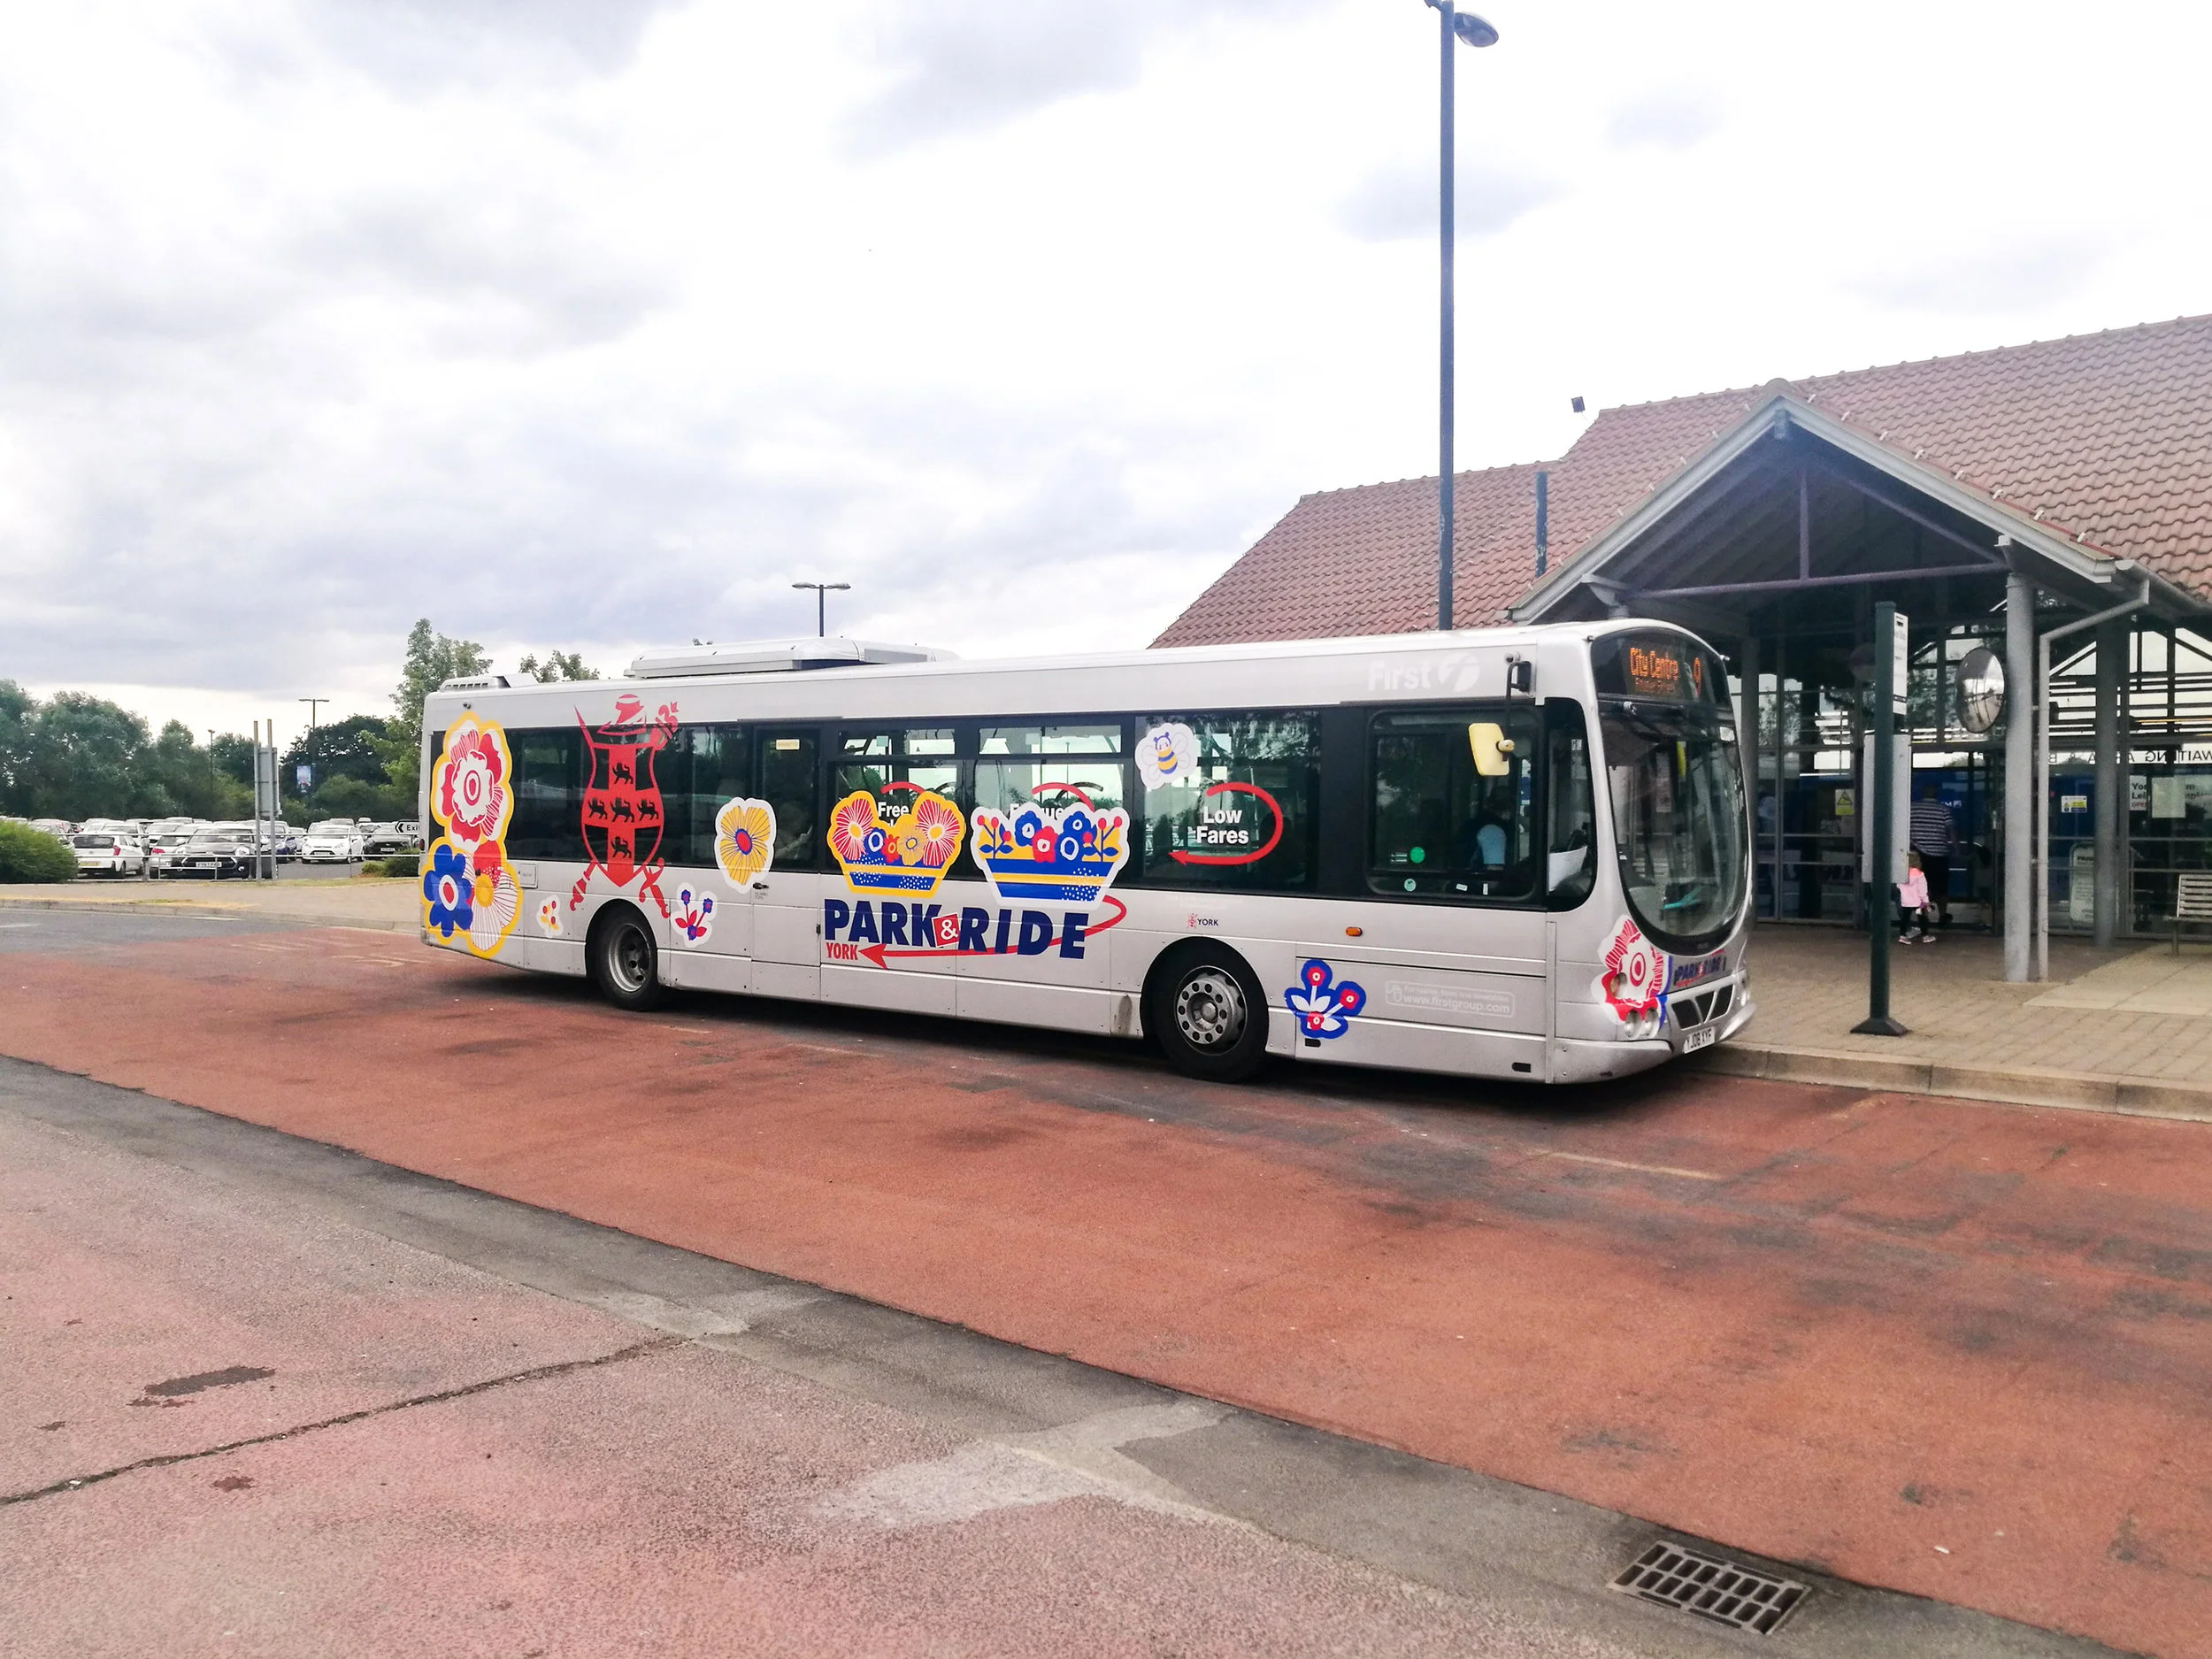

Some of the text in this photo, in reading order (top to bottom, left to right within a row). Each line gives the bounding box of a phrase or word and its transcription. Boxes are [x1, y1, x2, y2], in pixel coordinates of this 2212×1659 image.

[1630, 647, 1648, 677] City
[1368, 659, 1432, 690] First
[878, 802, 910, 818] Free
[1203, 806, 1242, 824] Low
[1196, 826, 1248, 844] Fares
[824, 898, 1089, 959] PARK & RIDE
[826, 942, 858, 961] YORK
[1403, 995, 1509, 1013] www.firstgroup.com
